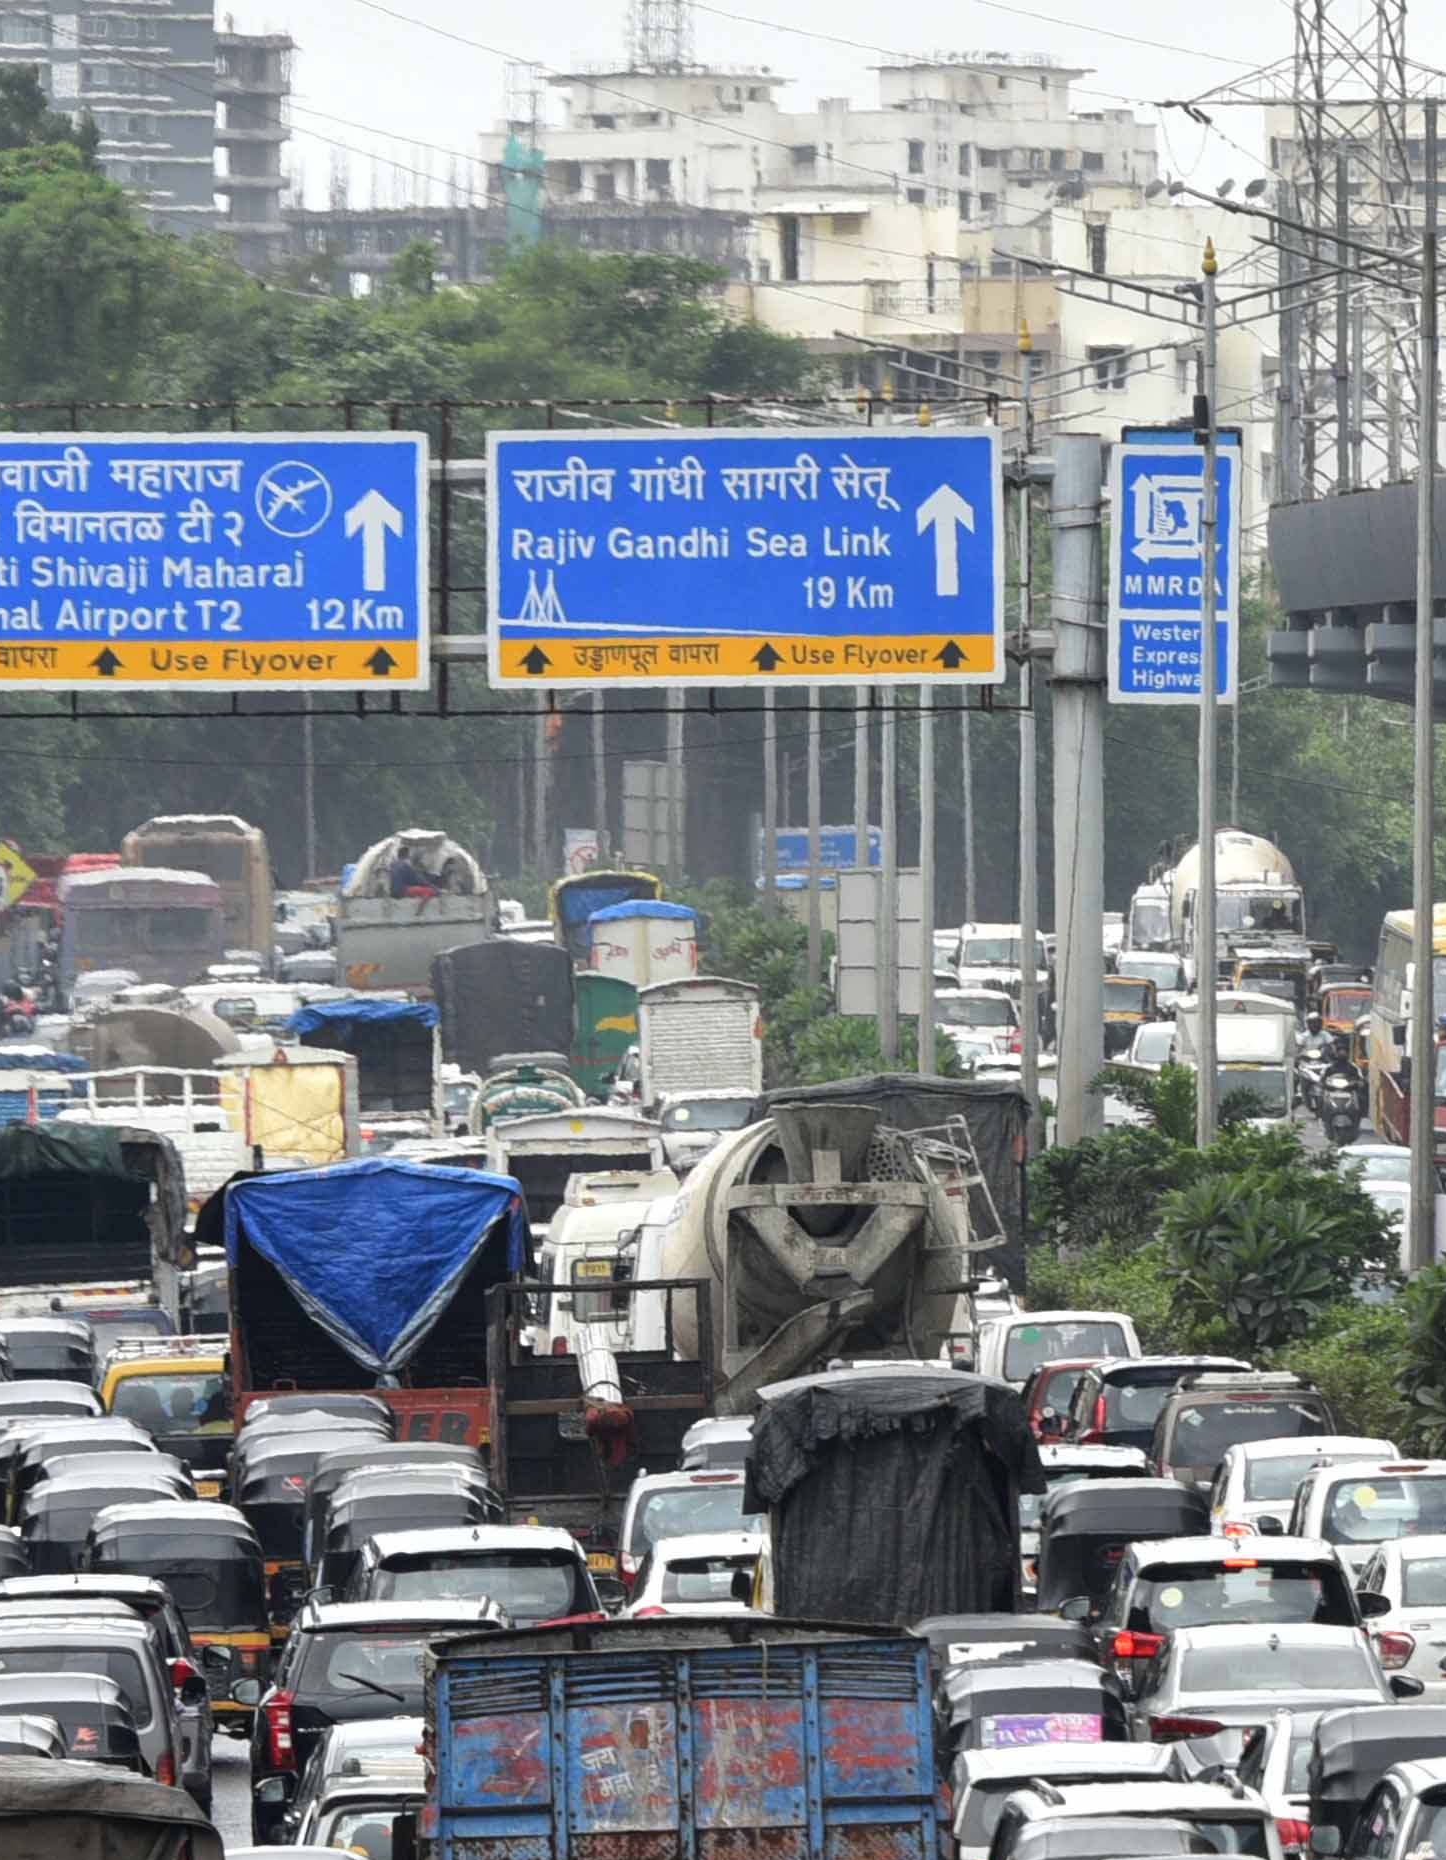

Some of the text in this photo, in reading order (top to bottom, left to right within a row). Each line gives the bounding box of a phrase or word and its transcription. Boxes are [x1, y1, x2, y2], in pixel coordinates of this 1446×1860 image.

[110, 460, 243, 497] महाराज
[513, 454, 900, 511] राजीव गांधी सागरी सेतू
[14, 495, 165, 543] विमानतळ
[178, 499, 214, 543] टी
[224, 512, 243, 546] २
[513, 527, 890, 564] Rajiv Gandhi Sea Link
[32, 556, 147, 593] Shivaji
[164, 552, 303, 588] Maharaj
[804, 576, 893, 608] 19 Km
[57, 600, 186, 636] Airport
[197, 600, 241, 631] T2
[308, 599, 345, 630] 12
[353, 599, 403, 629] Km
[1132, 624, 1203, 641] Wester
[152, 650, 333, 675] Use Flyover
[792, 644, 926, 664] Use Flyover
[1132, 645, 1203, 666] Expres
[1132, 669, 1203, 689] Highwa
